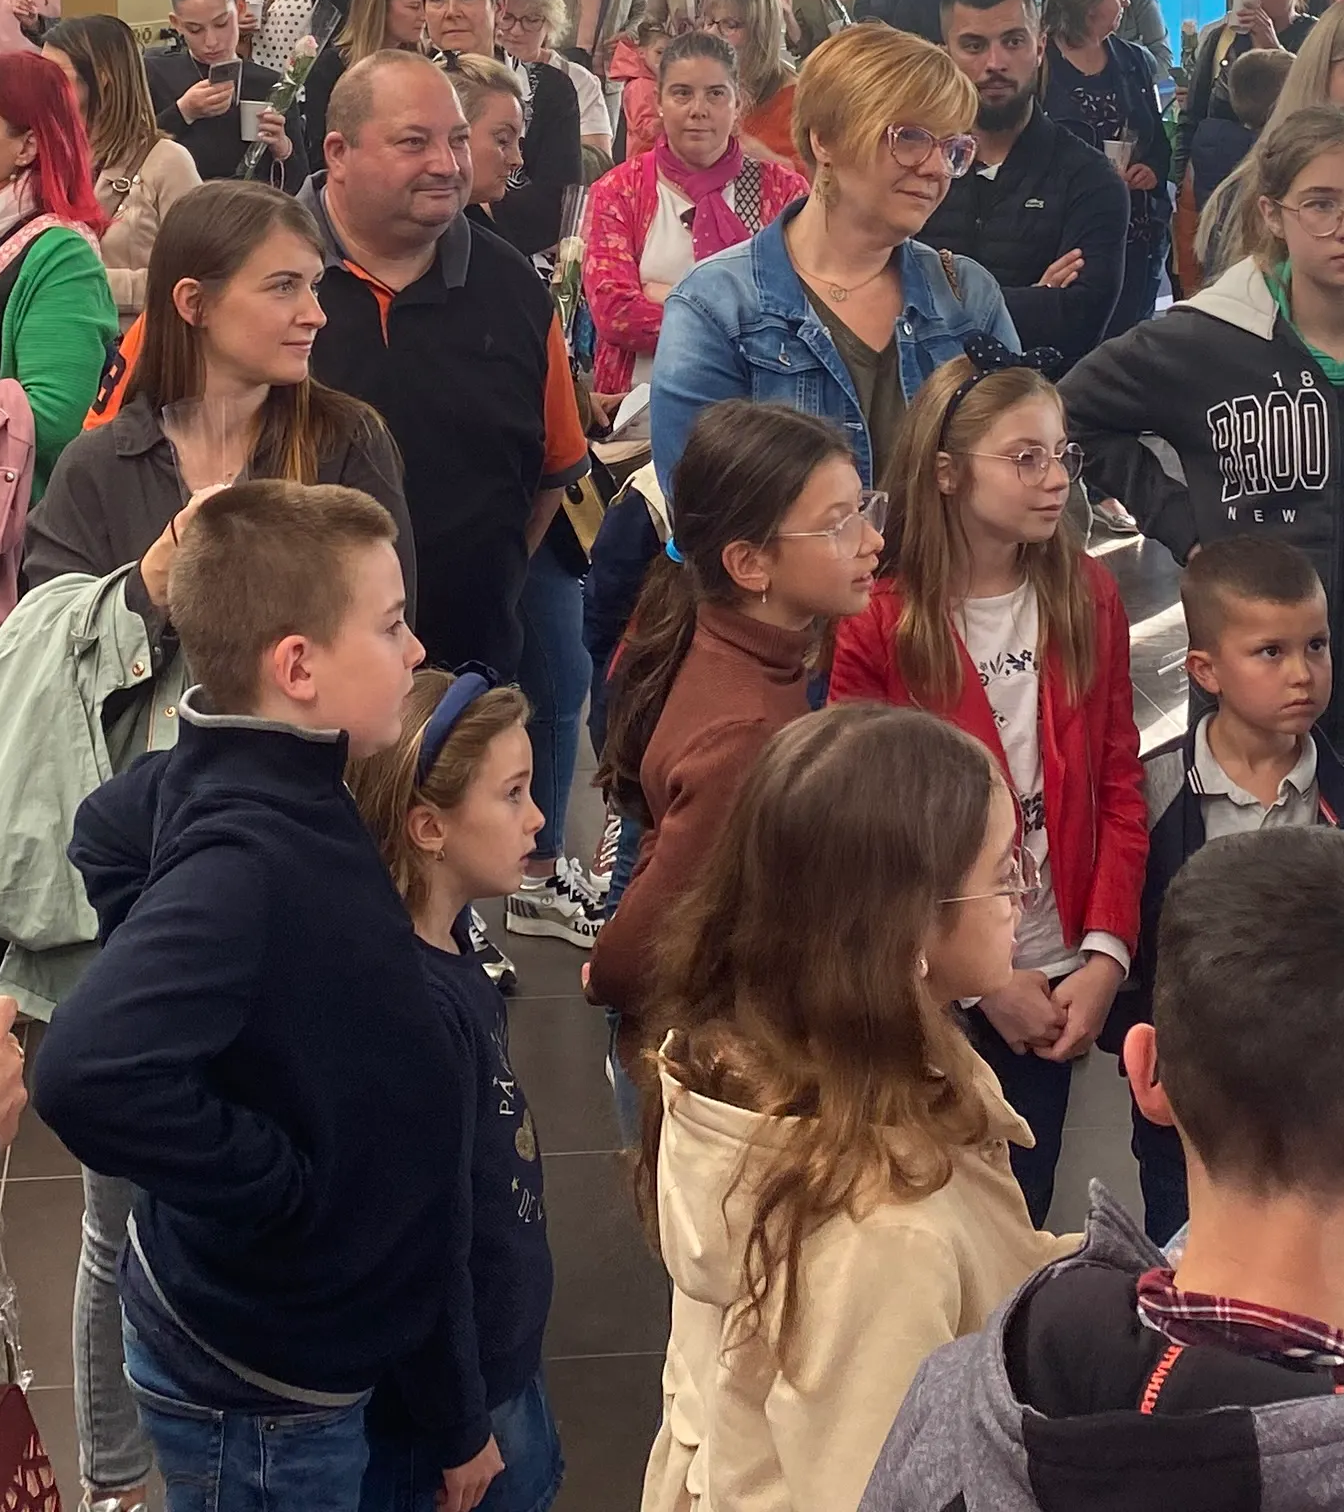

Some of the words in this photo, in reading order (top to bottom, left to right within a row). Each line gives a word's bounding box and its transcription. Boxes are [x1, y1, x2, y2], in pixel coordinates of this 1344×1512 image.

[1227, 506, 1297, 524] NEW
[573, 921, 602, 938] LOV
[1140, 1344, 1184, 1416] RTHVILLE
